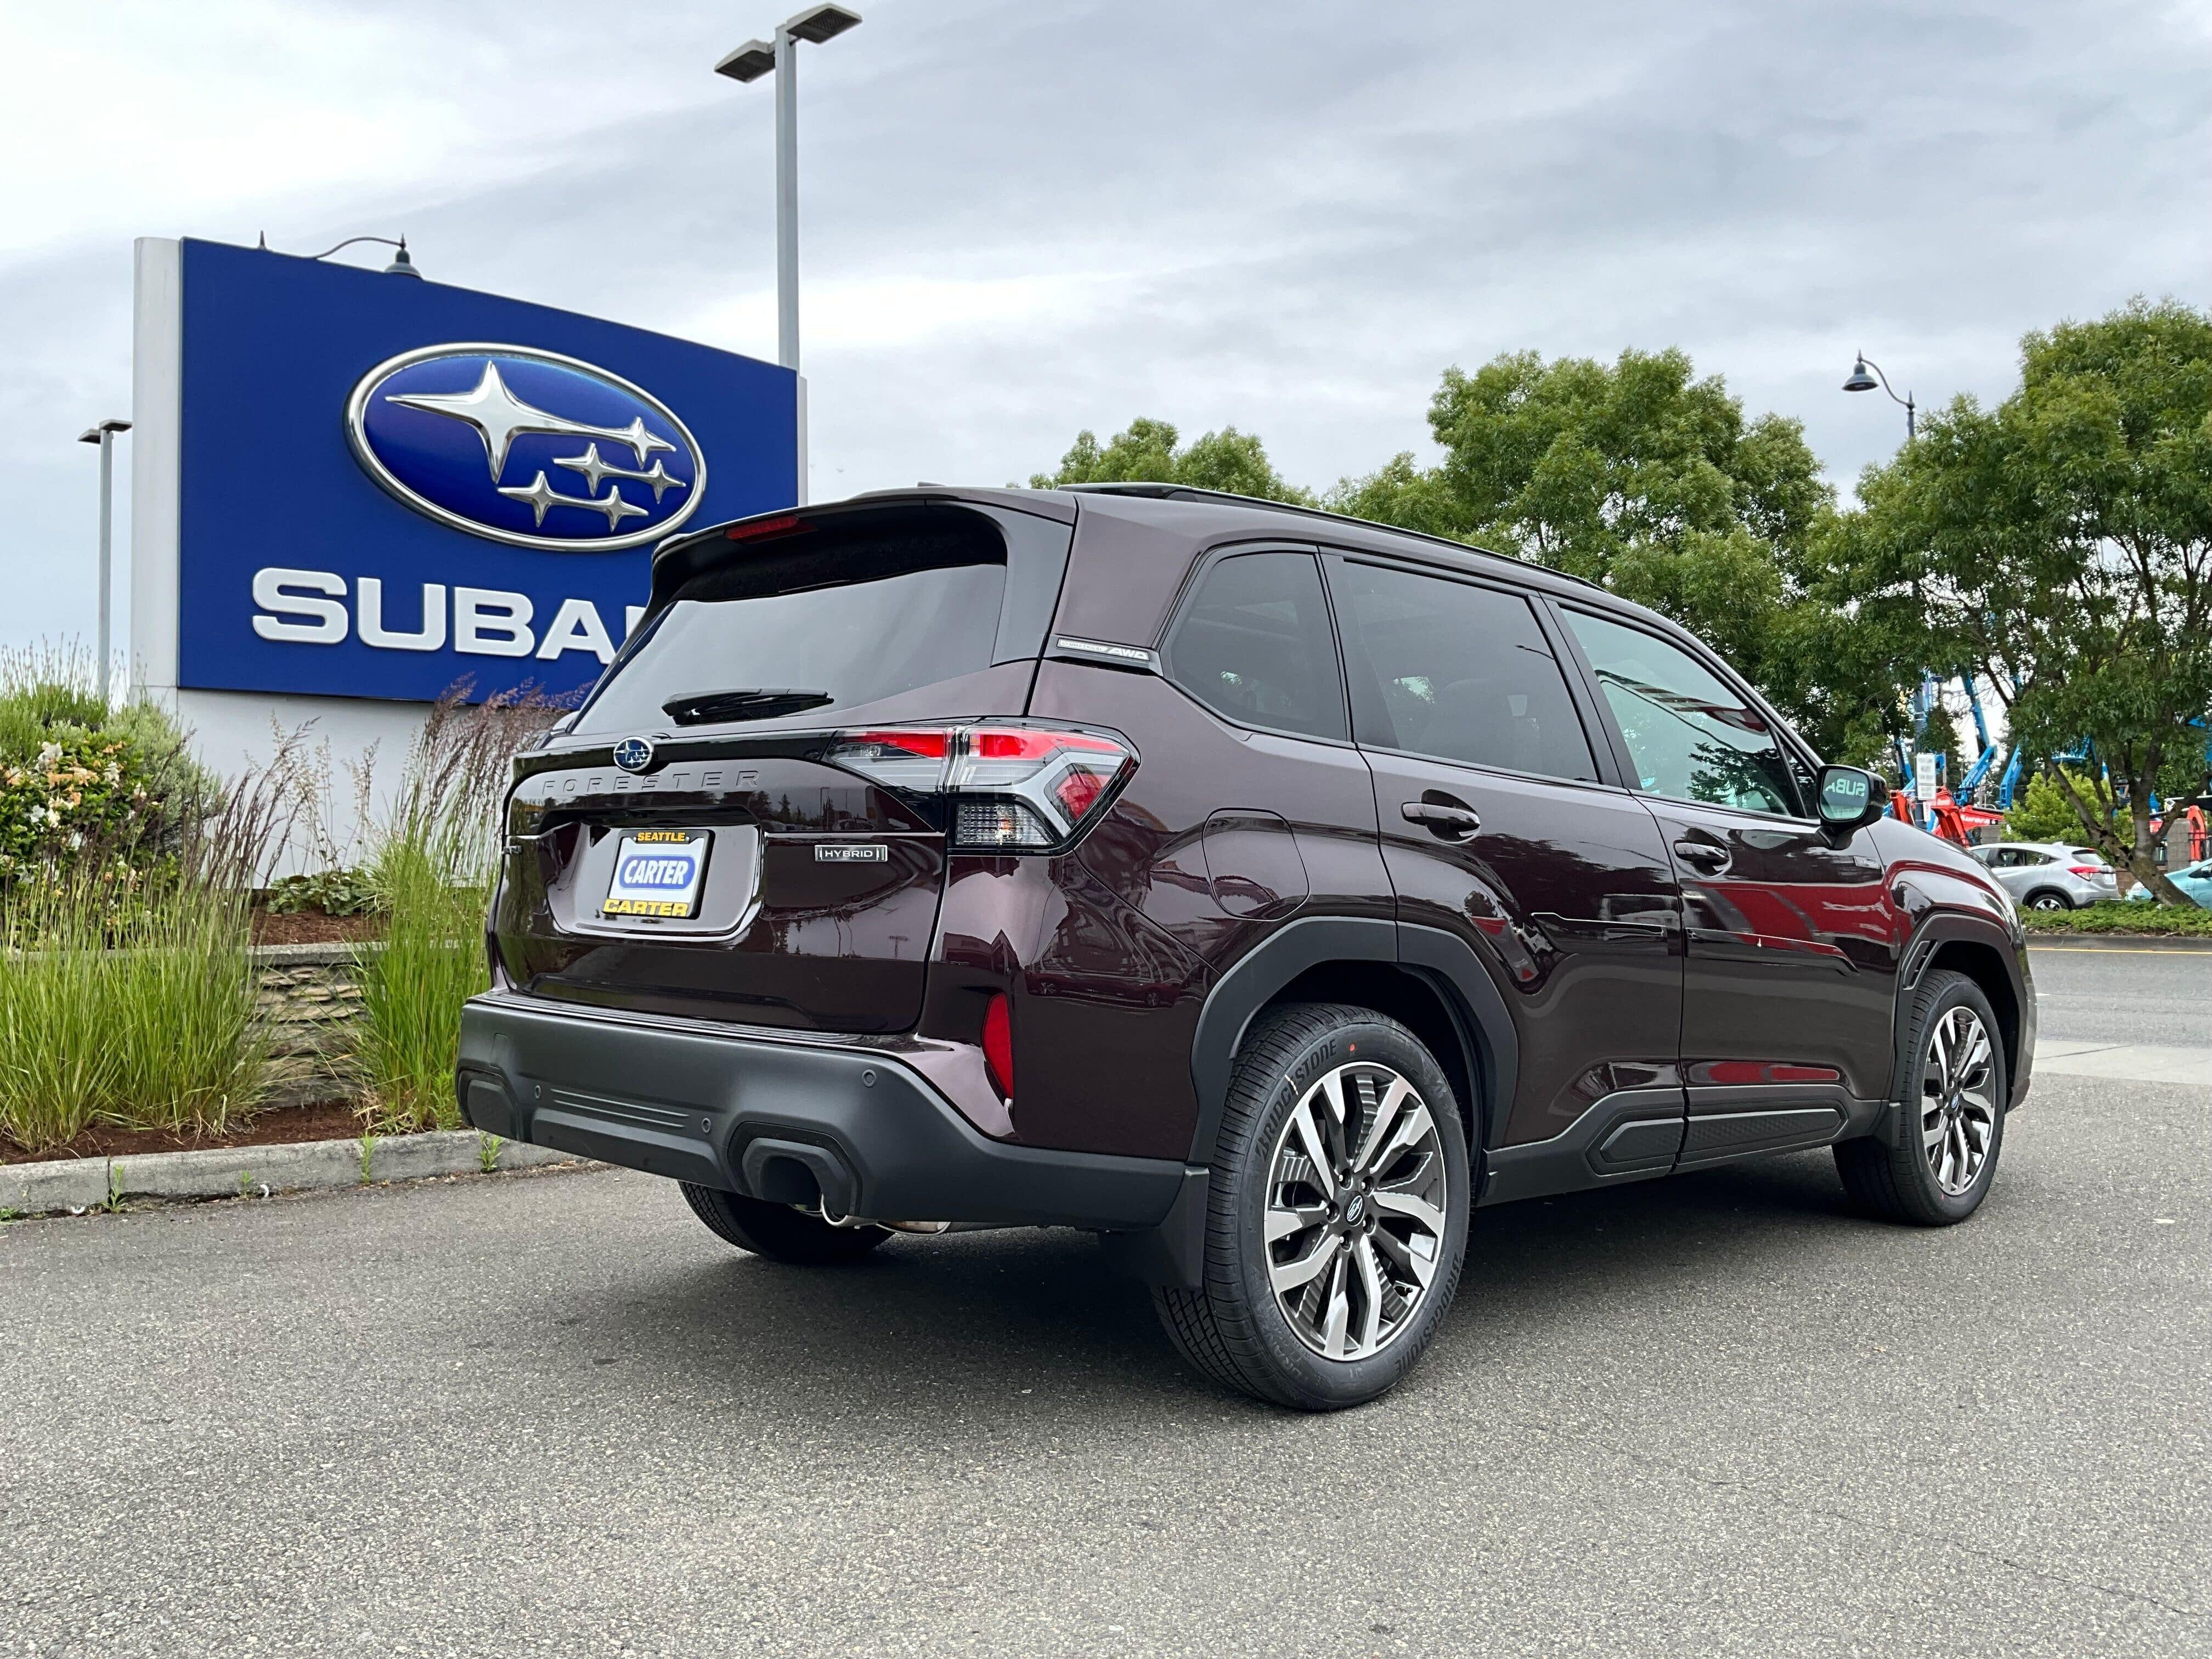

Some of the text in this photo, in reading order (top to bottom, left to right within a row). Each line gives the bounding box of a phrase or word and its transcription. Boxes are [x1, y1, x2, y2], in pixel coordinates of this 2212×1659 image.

[252, 567, 648, 665] SUBA
[1107, 647, 1149, 661] AWD
[541, 770, 759, 795] FORESTER
[637, 832, 686, 842] SEATTLE
[624, 859, 689, 885] CARTER
[603, 899, 689, 917] CARTER
